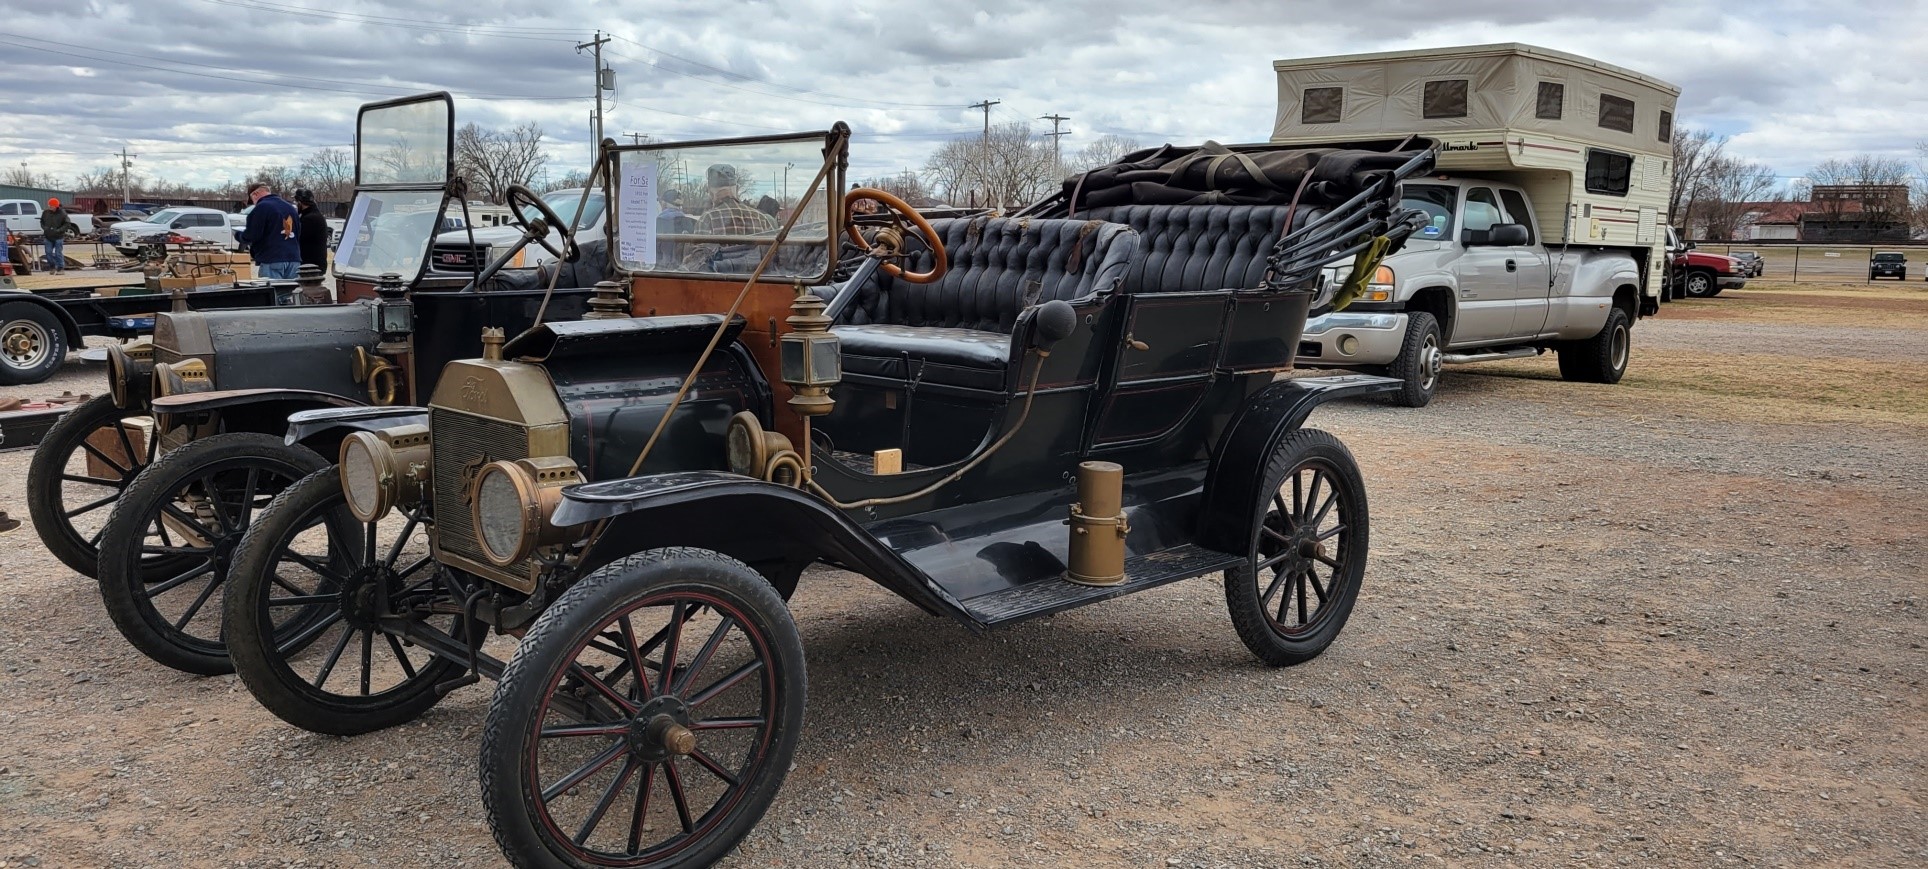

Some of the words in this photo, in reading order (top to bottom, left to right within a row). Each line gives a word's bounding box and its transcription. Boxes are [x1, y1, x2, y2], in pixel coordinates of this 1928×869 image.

[1442, 141, 1478, 151] llmark
[630, 175, 640, 185] For
[442, 253, 467, 263] GMC
[458, 375, 488, 404] Ford
